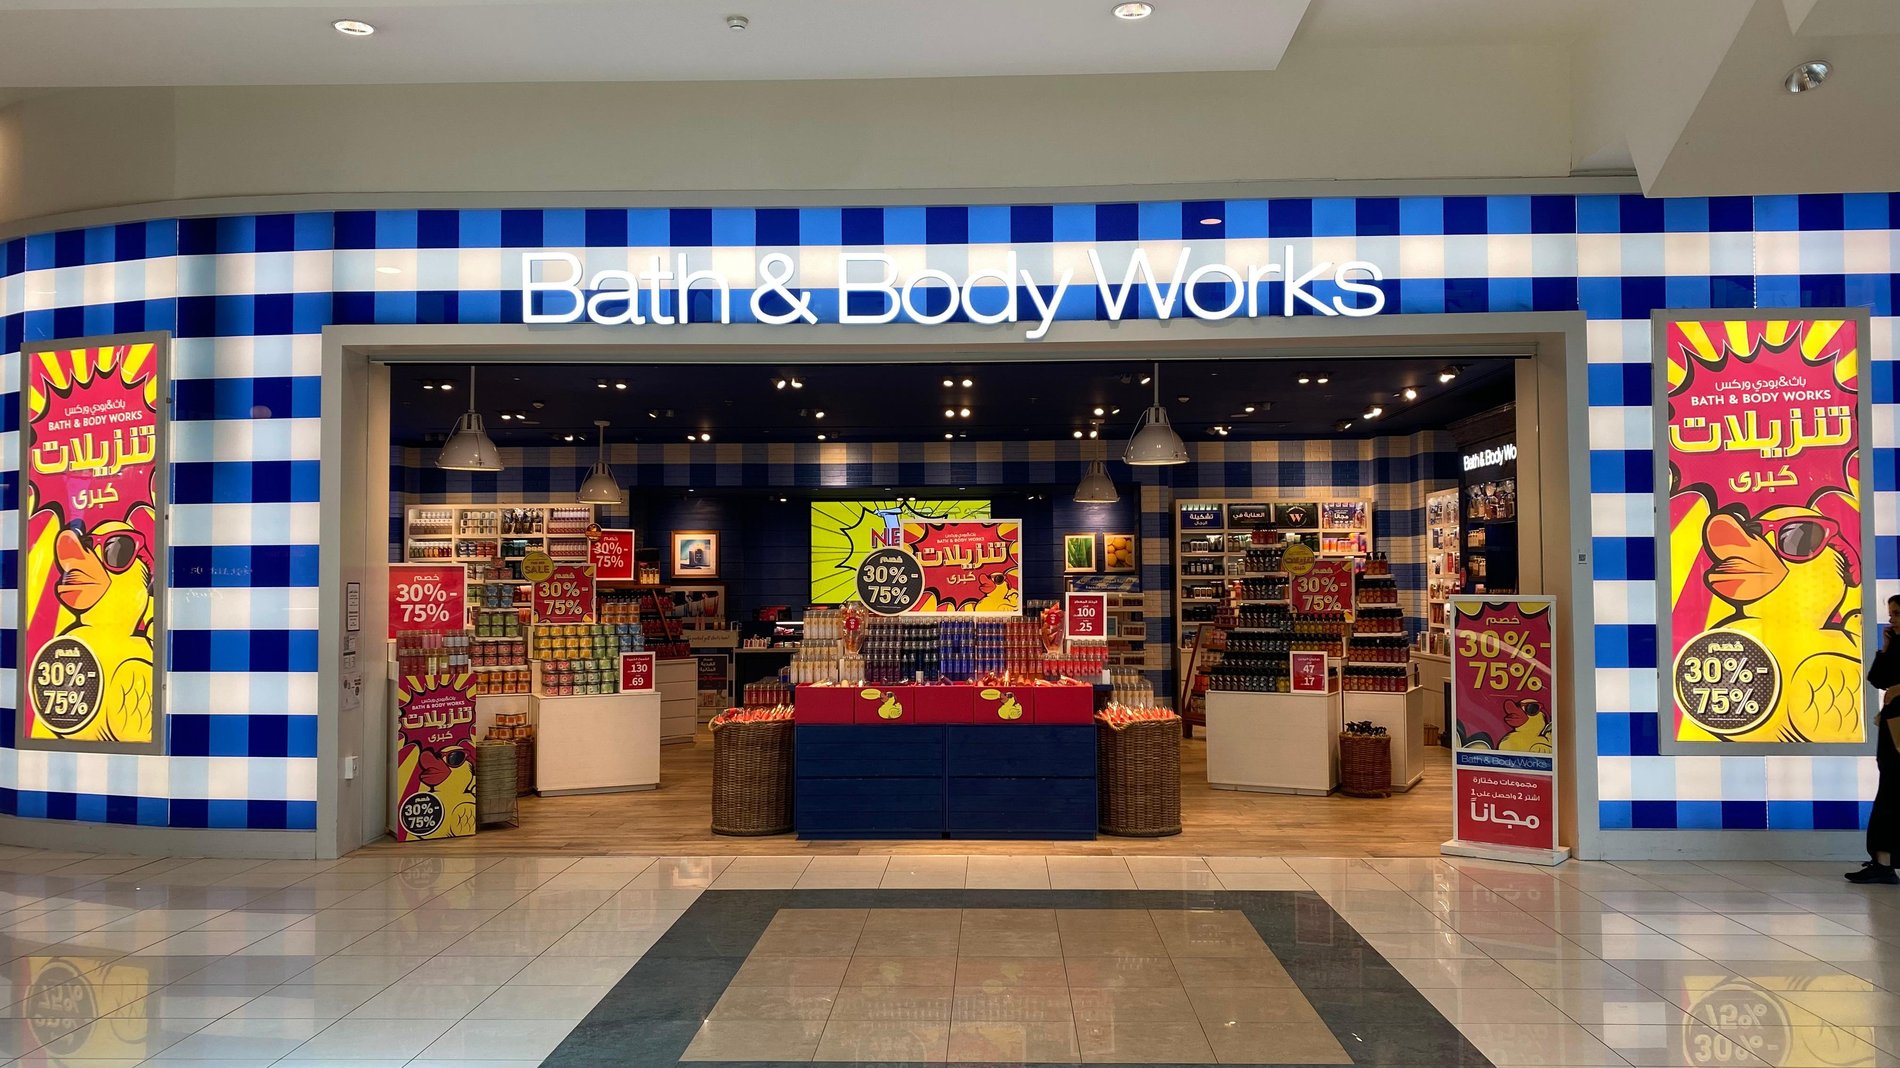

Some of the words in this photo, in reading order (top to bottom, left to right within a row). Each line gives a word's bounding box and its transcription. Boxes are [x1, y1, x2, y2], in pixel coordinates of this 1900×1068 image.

[522, 252, 730, 326] Bath
[749, 252, 818, 326] &
[838, 250, 1074, 339] Body
[1087, 245, 1386, 321] Works
[1691, 395, 1725, 406] BATH
[1729, 394, 1738, 405] &
[1743, 392, 1779, 404] BODY
[1782, 389, 1831, 401] WORKS
[48, 420, 71, 431] BATH
[74, 419, 81, 428] &
[83, 415, 107, 427] BODY
[109, 410, 143, 423] WORKS
[1668, 405, 1852, 459] تنزيلات
[32, 424, 156, 477] تنزيلات
[1463, 453, 1480, 471] Bath
[1479, 451, 1486, 467] &
[1485, 446, 1504, 466] Body
[1729, 464, 1799, 493] كبرى
[72, 483, 119, 510] كبرى
[1289, 513, 1304, 522] W
[596, 555, 624, 568] 75%
[880, 555, 903, 564] خصم
[915, 541, 1007, 570] تنزيلات
[524, 565, 550, 574] SALE
[413, 573, 440, 582] خصم
[946, 571, 976, 584] كبرى
[868, 585, 910, 604] 75%
[544, 599, 583, 615] 75%
[1302, 595, 1341, 611] 75%
[400, 603, 450, 622] 75%
[1077, 607, 1096, 617] 100
[1079, 622, 1093, 632] 25
[1486, 615, 1521, 626] خصم
[55, 647, 81, 659] خصم
[1707, 640, 1744, 653] خصم
[631, 664, 648, 673] 130
[1303, 664, 1315, 673] 47
[632, 677, 644, 686] 69
[1304, 677, 1315, 686] 17
[1469, 661, 1543, 691] 75%
[43, 690, 88, 715] 75%
[1693, 687, 1759, 715] 75%
[402, 706, 473, 729] تنزيلات
[427, 730, 453, 743] كبرى
[1461, 754, 1483, 764] Bath
[1484, 756, 1491, 764] &
[1491, 756, 1516, 768] Body
[1516, 758, 1548, 769] Works
[1472, 775, 1498, 786] مختارة
[1500, 779, 1538, 788] مجموعات
[1470, 788, 1476, 796] 1
[1476, 790, 1491, 798] على
[1491, 791, 1517, 800] واحصل
[1517, 792, 1523, 800] 2
[408, 815, 436, 829] 75%
